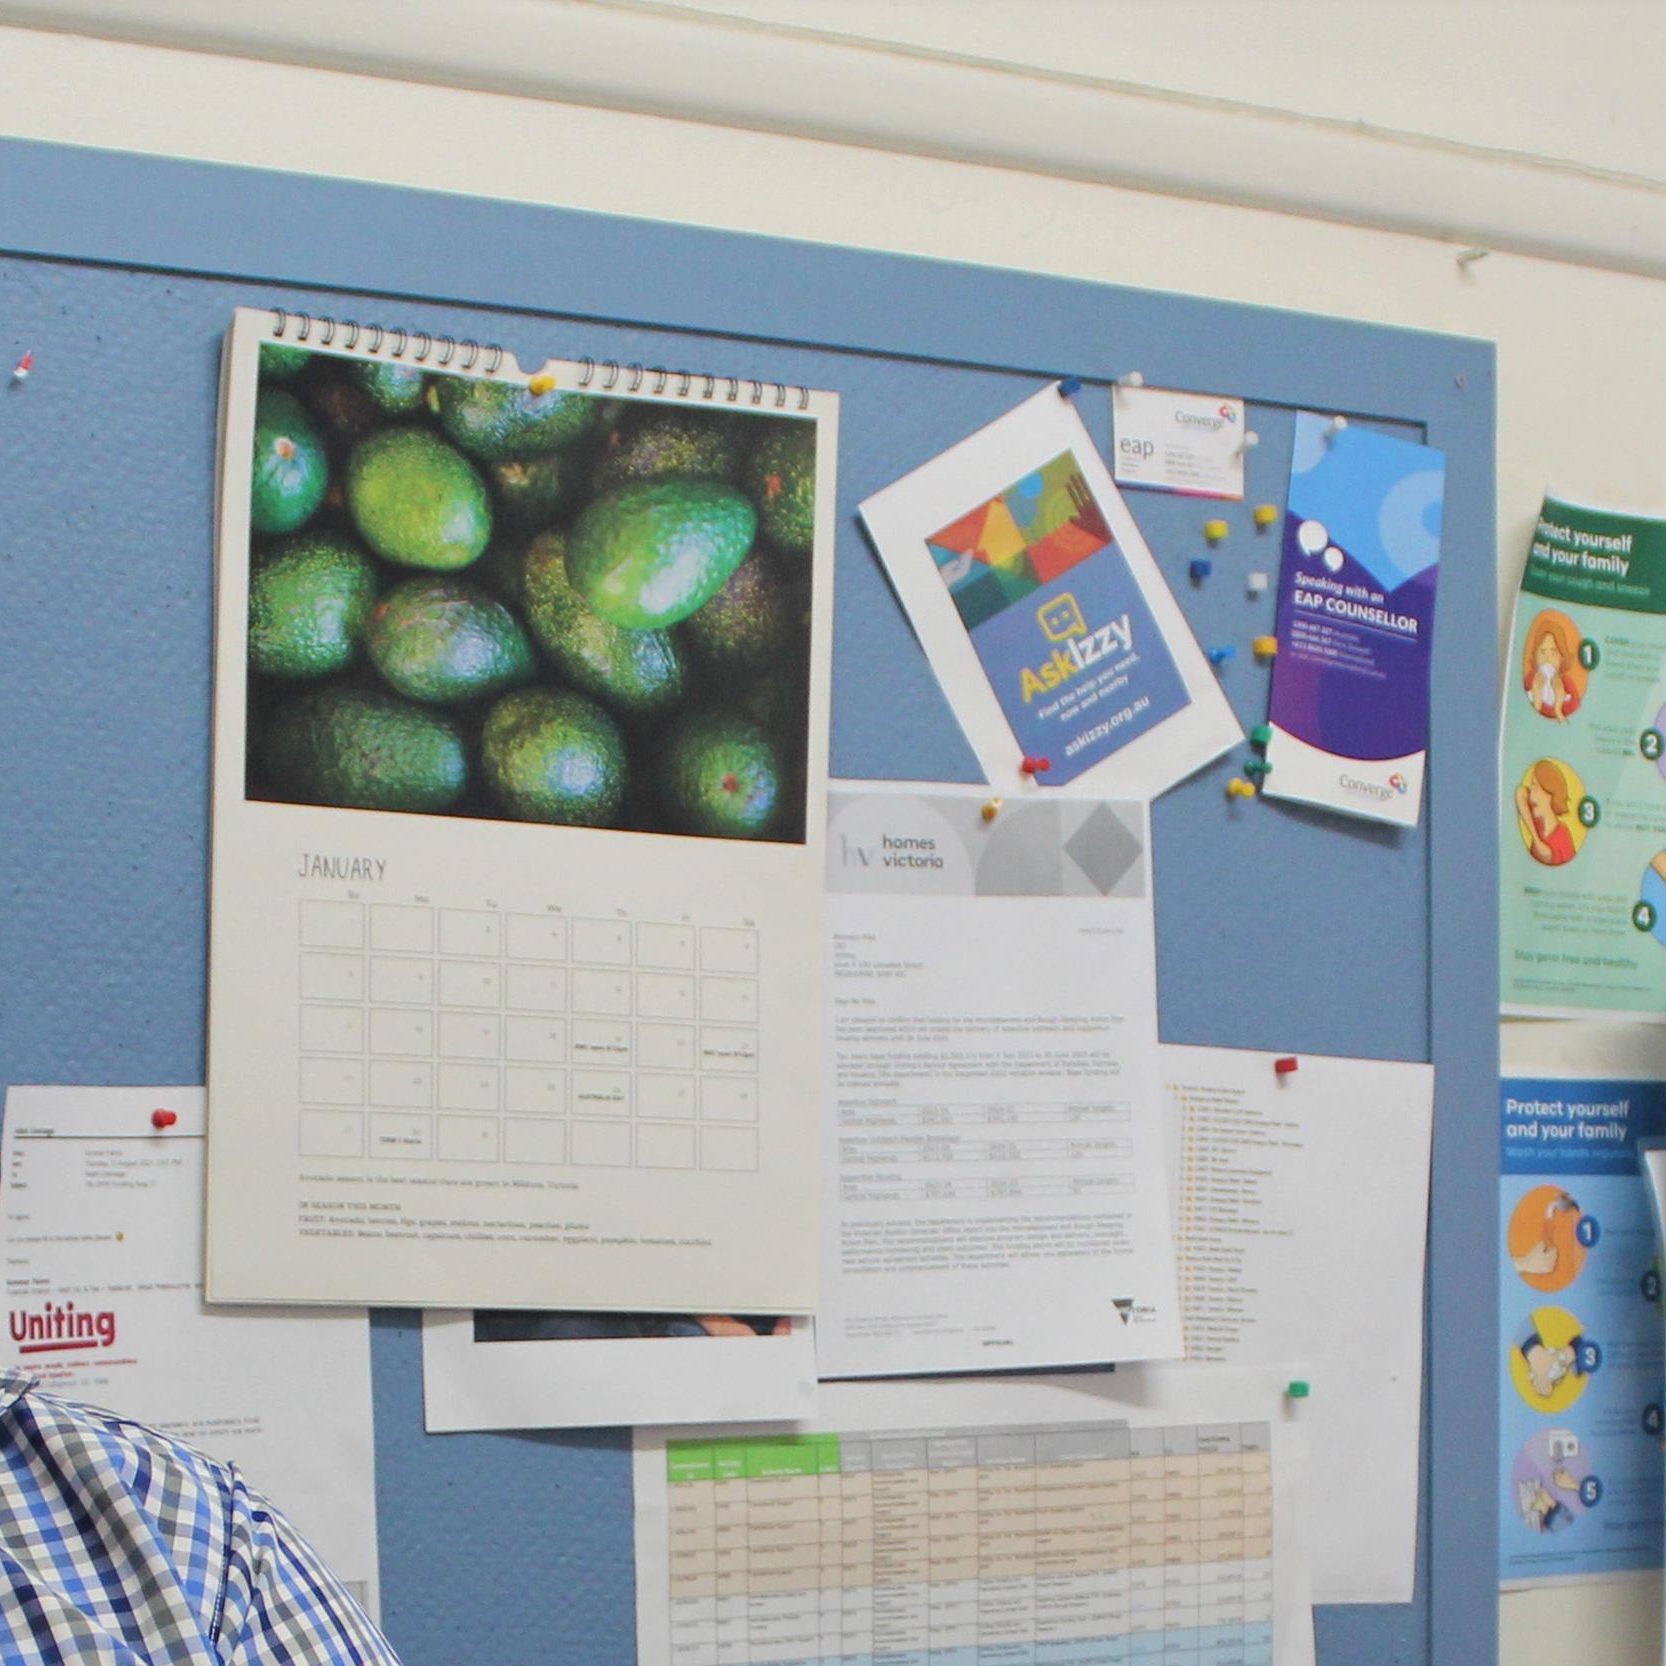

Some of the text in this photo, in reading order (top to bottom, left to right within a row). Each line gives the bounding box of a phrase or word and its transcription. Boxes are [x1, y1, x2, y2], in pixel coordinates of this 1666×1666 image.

[1120, 438, 1154, 460] eap
[1573, 530, 1633, 554] yourself
[1533, 542, 1630, 578] and your family
[1296, 570, 1343, 596] Speaking
[1345, 584, 1369, 600] with
[1294, 589, 1418, 635] EAP COUNSELLOR
[1584, 644, 1593, 664] 1
[1065, 696, 1150, 756] askizzy.org.au
[1646, 734, 1658, 754] 2
[1583, 801, 1595, 822] 3
[883, 833, 935, 850] homes
[298, 853, 387, 881] JANUARY
[883, 852, 944, 868] victoria
[1636, 905, 1650, 926] 4
[1506, 1099, 1630, 1119] Protect yourself
[1507, 1121, 1628, 1142] and your family
[1583, 1222, 1592, 1241] 1
[8, 1301, 116, 1348] Uniting
[1584, 1347, 1596, 1366] 3
[1585, 1482, 1597, 1500] 5
